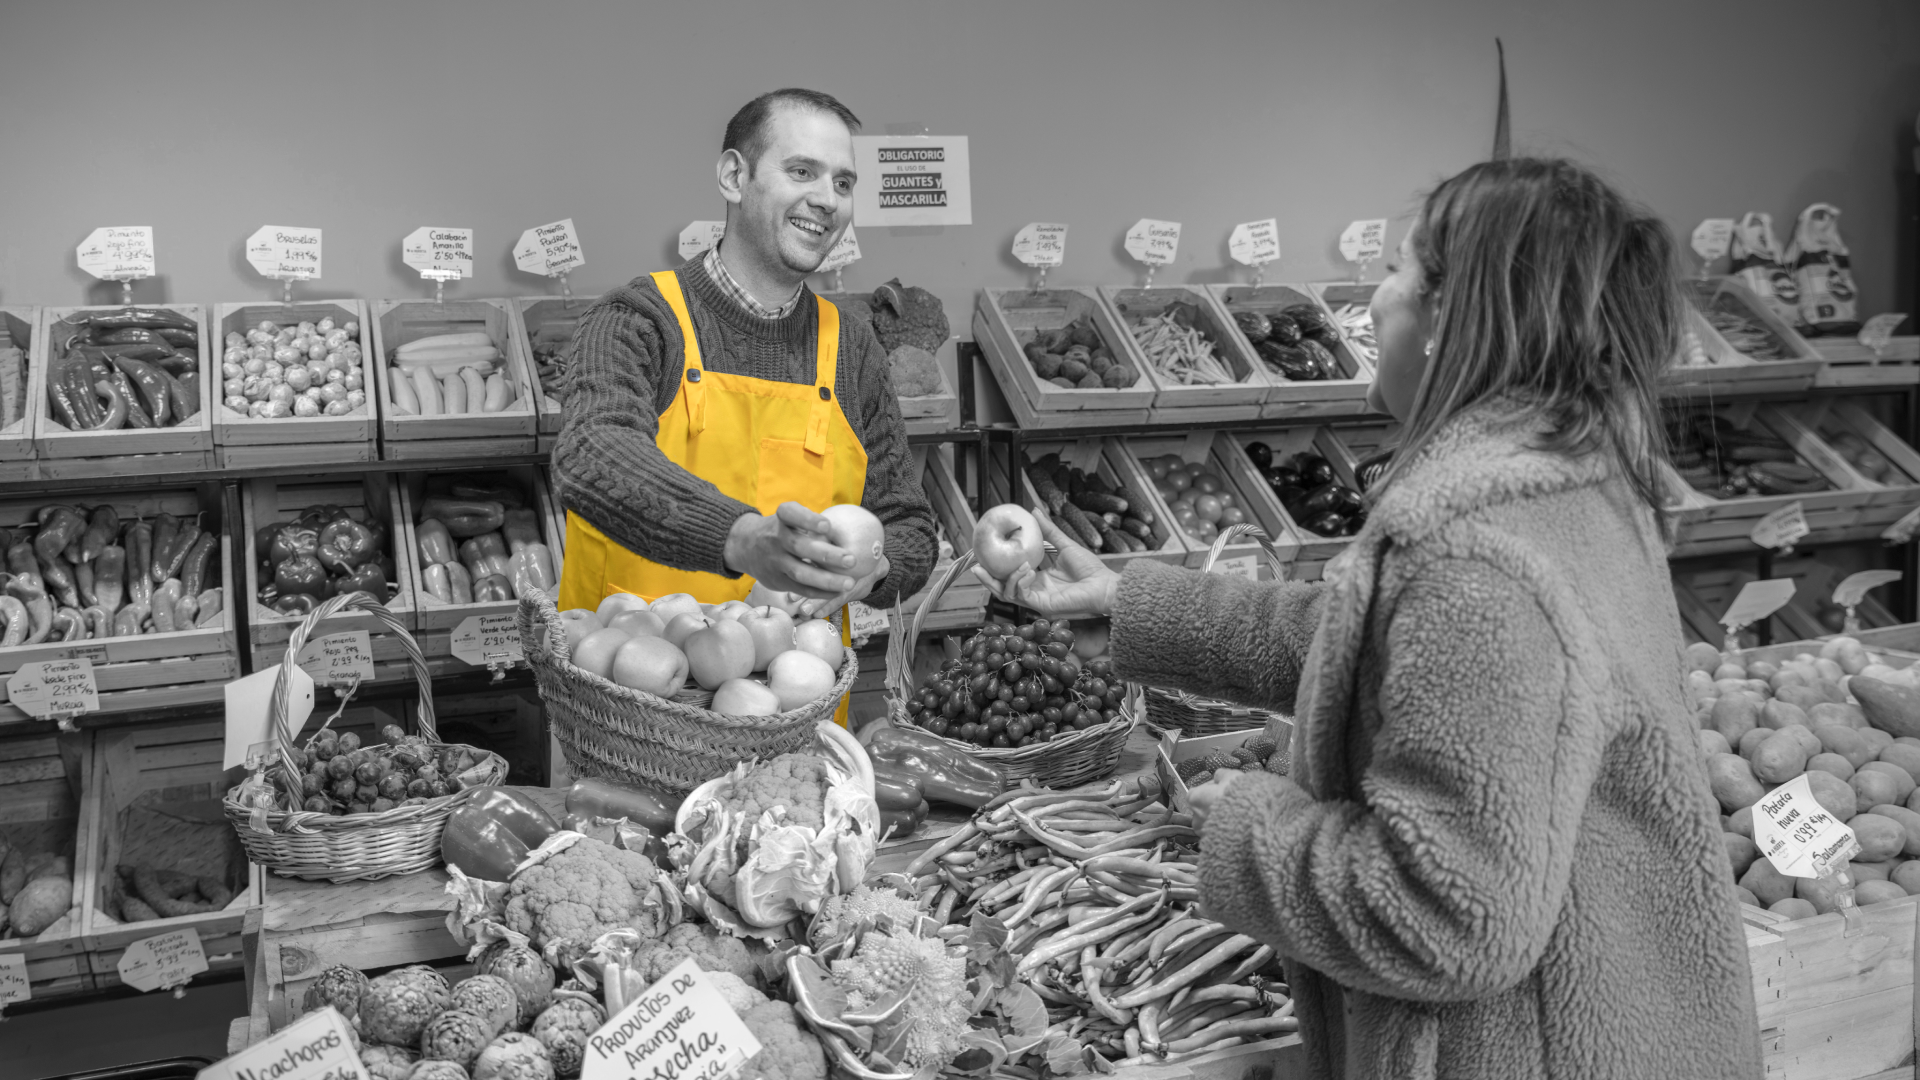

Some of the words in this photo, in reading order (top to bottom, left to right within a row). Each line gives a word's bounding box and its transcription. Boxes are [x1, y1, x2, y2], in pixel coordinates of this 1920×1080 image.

[878, 150, 944, 161] OBLIGATORIO
[883, 176, 933, 187] GUANTES
[935, 178, 942, 189] y
[879, 194, 947, 206] MASCARILLA
[1762, 792, 1793, 819] Patata
